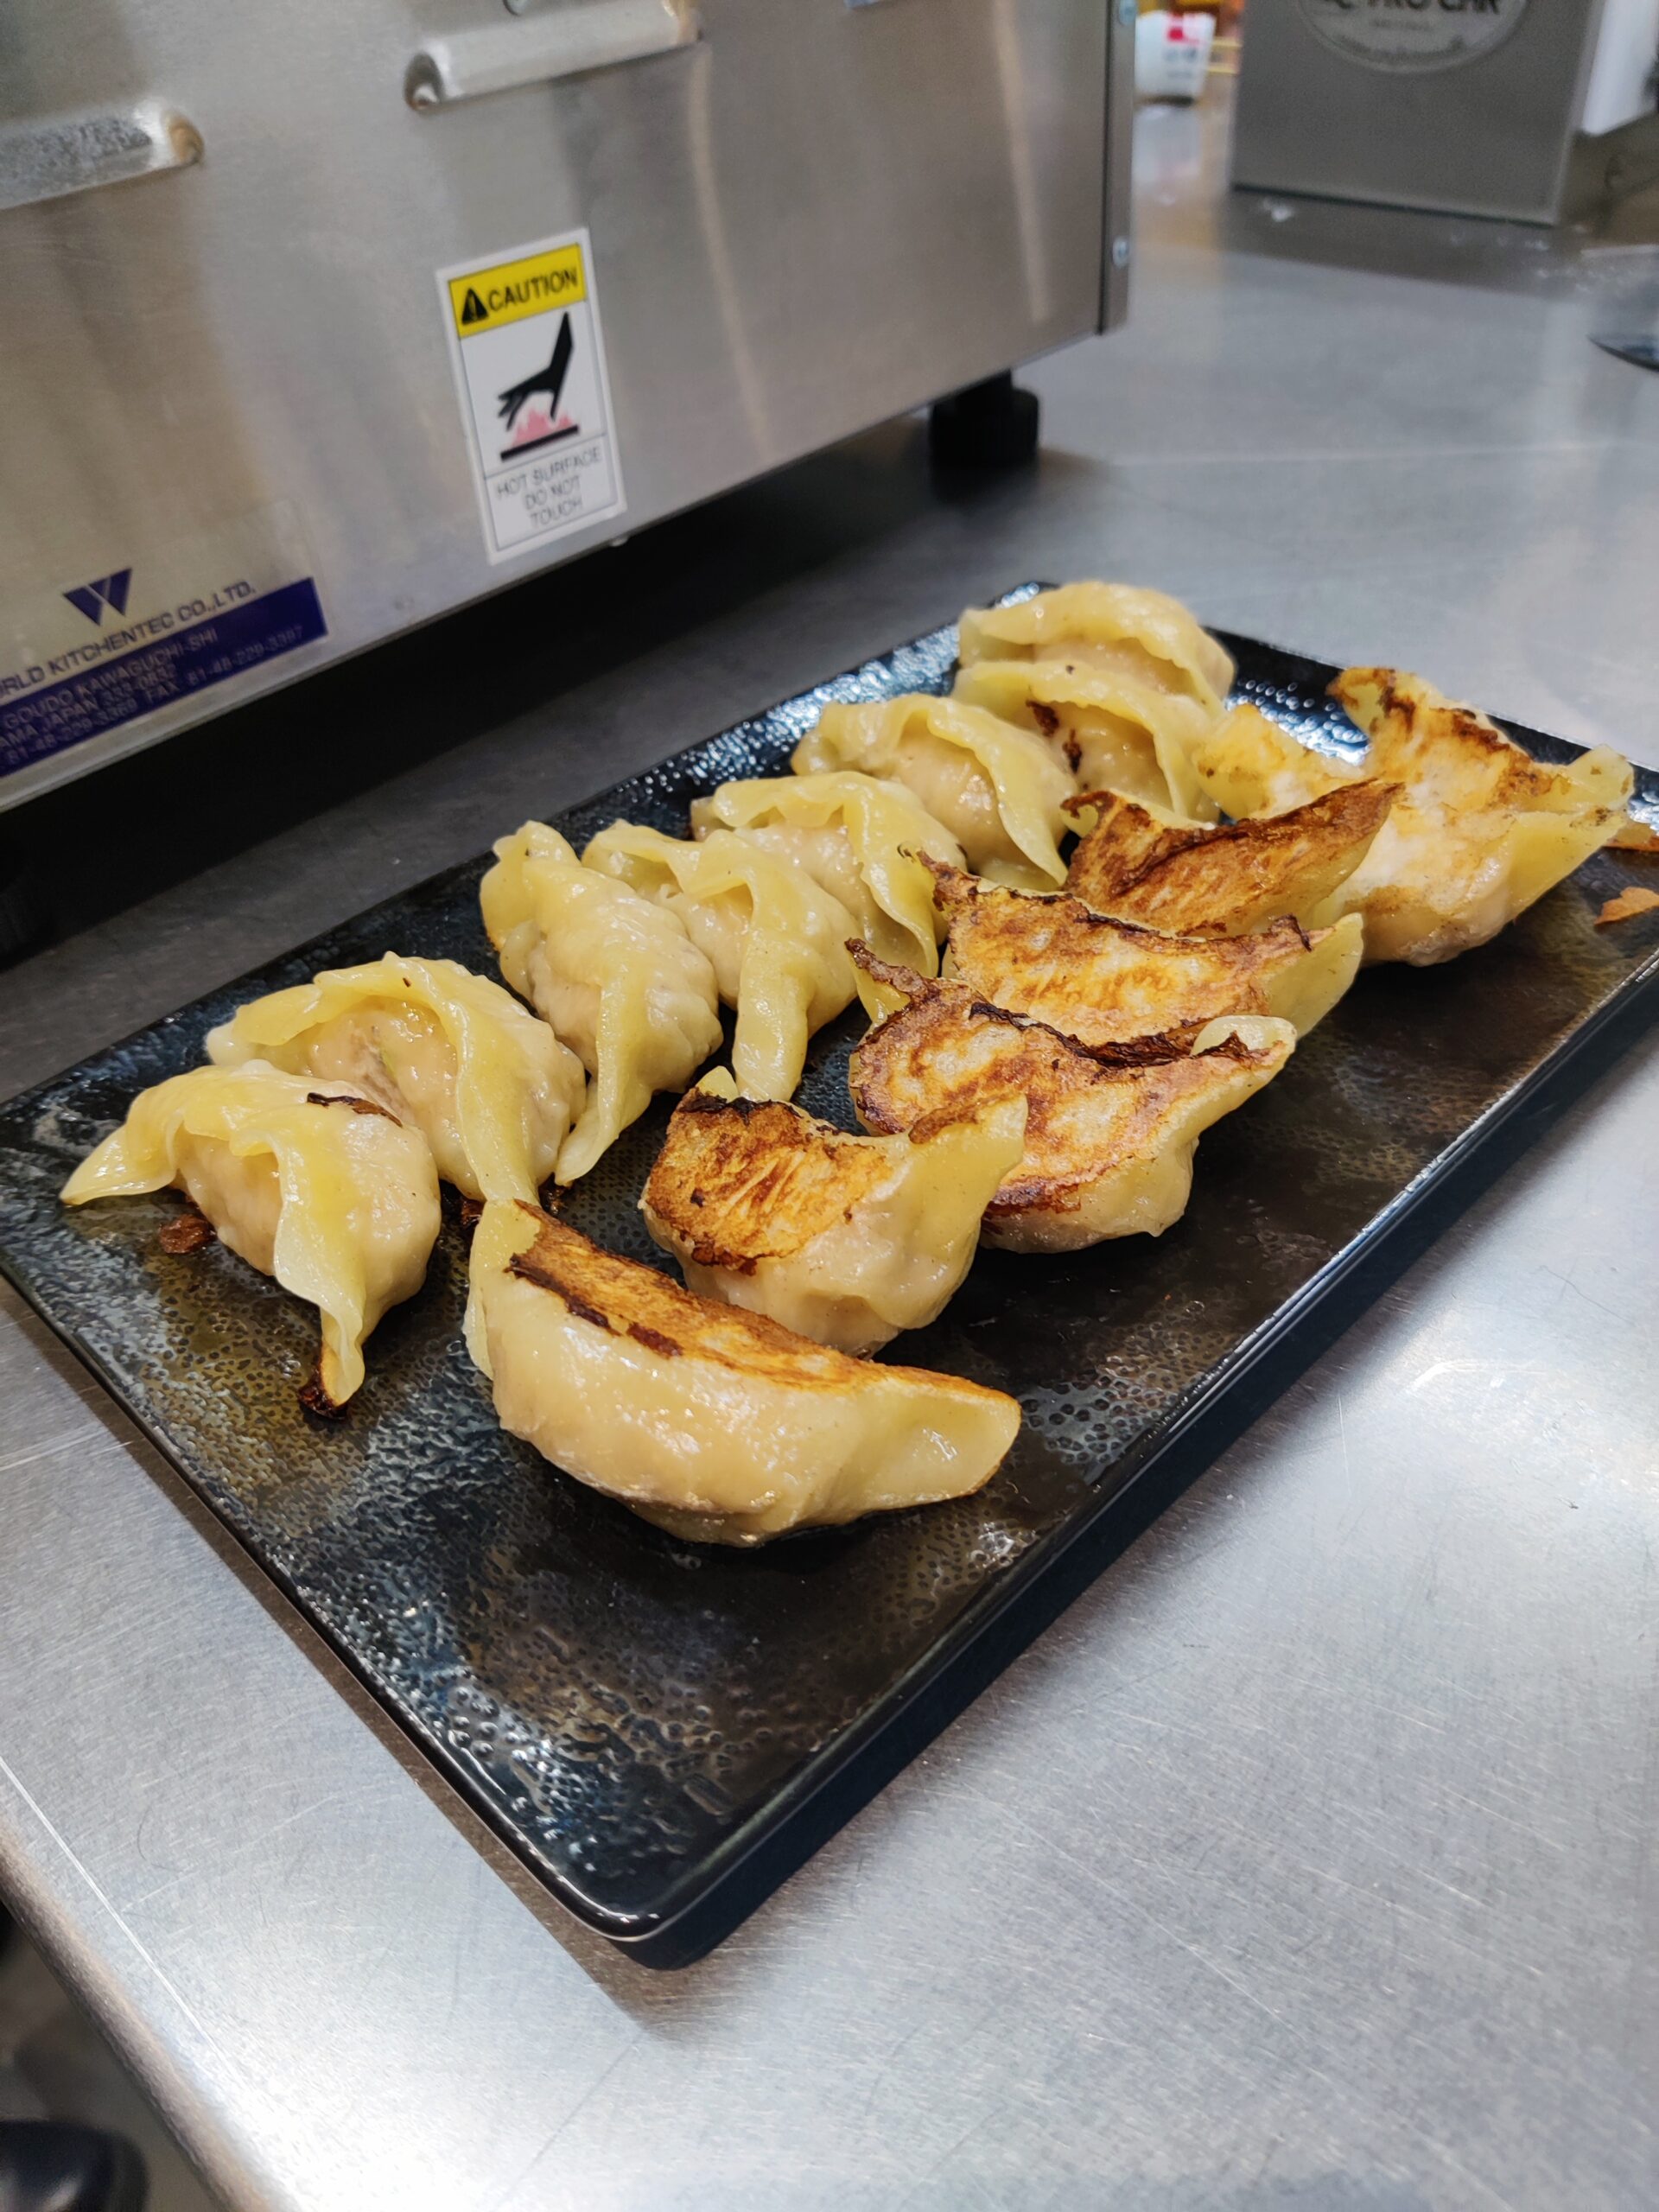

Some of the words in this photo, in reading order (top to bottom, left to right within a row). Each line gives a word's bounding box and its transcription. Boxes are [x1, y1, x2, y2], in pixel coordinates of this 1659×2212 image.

[488, 269, 579, 312] CAUTION
[497, 474, 528, 499] HOT
[532, 447, 602, 485] SURFACE
[525, 489, 548, 510] DO
[551, 474, 581, 496] NOT
[530, 499, 583, 528] TOUCH
[0, 665, 45, 698] RLD
[48, 613, 175, 675] KITCHENTEC
